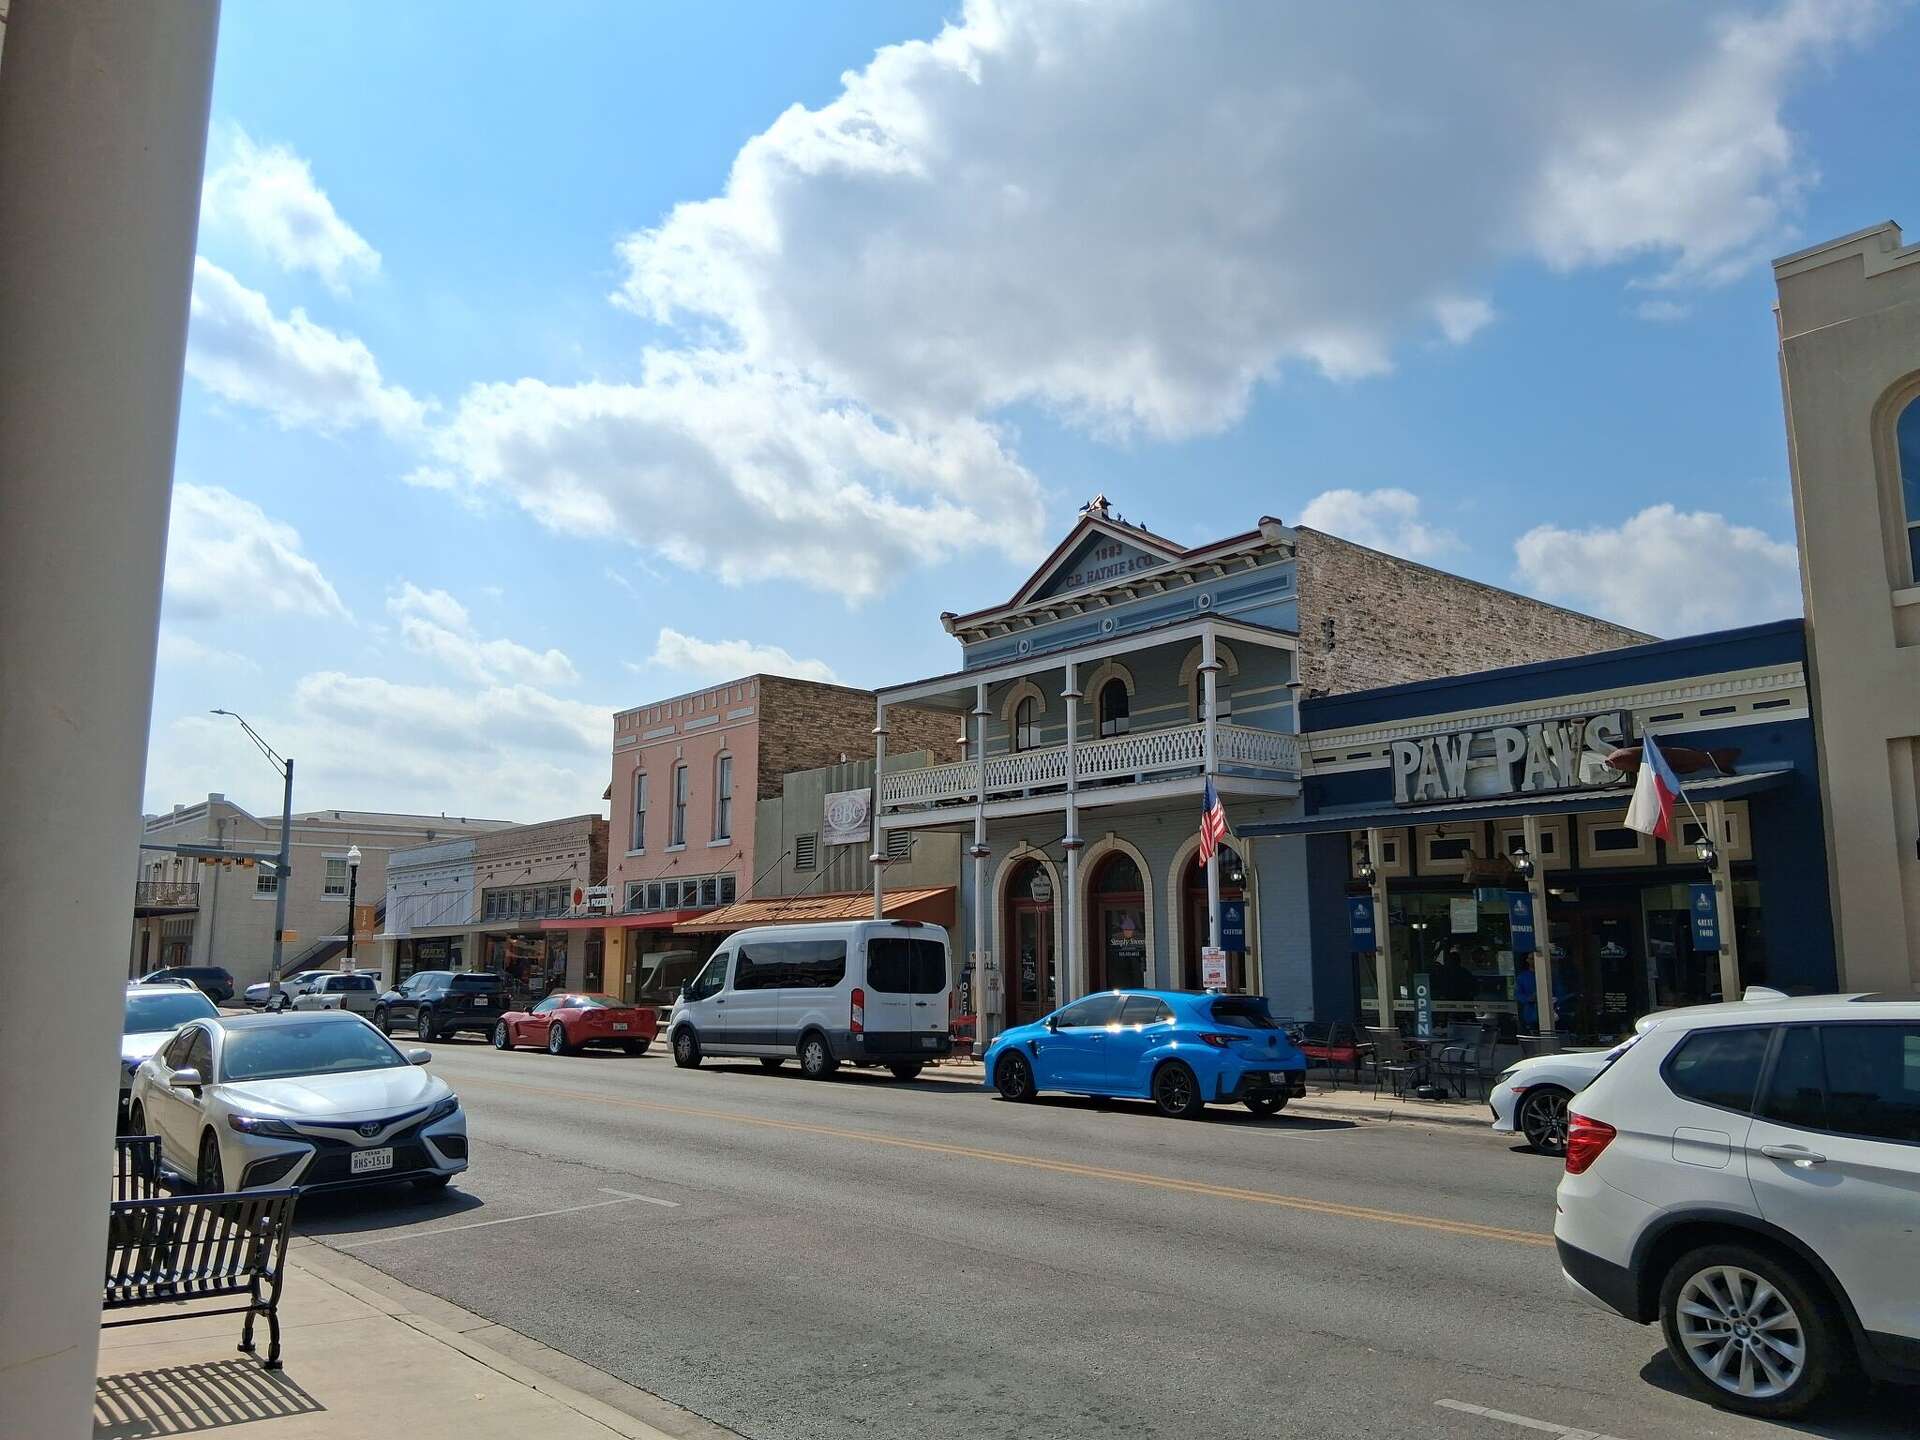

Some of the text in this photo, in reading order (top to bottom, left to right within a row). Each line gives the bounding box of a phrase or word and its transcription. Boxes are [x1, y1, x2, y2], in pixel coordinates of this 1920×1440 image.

[1095, 543, 1123, 561] 1883
[1087, 561, 1126, 583] HAYNIE
[1392, 733, 1472, 802] PAW
[1416, 984, 1430, 1036] OPEN
